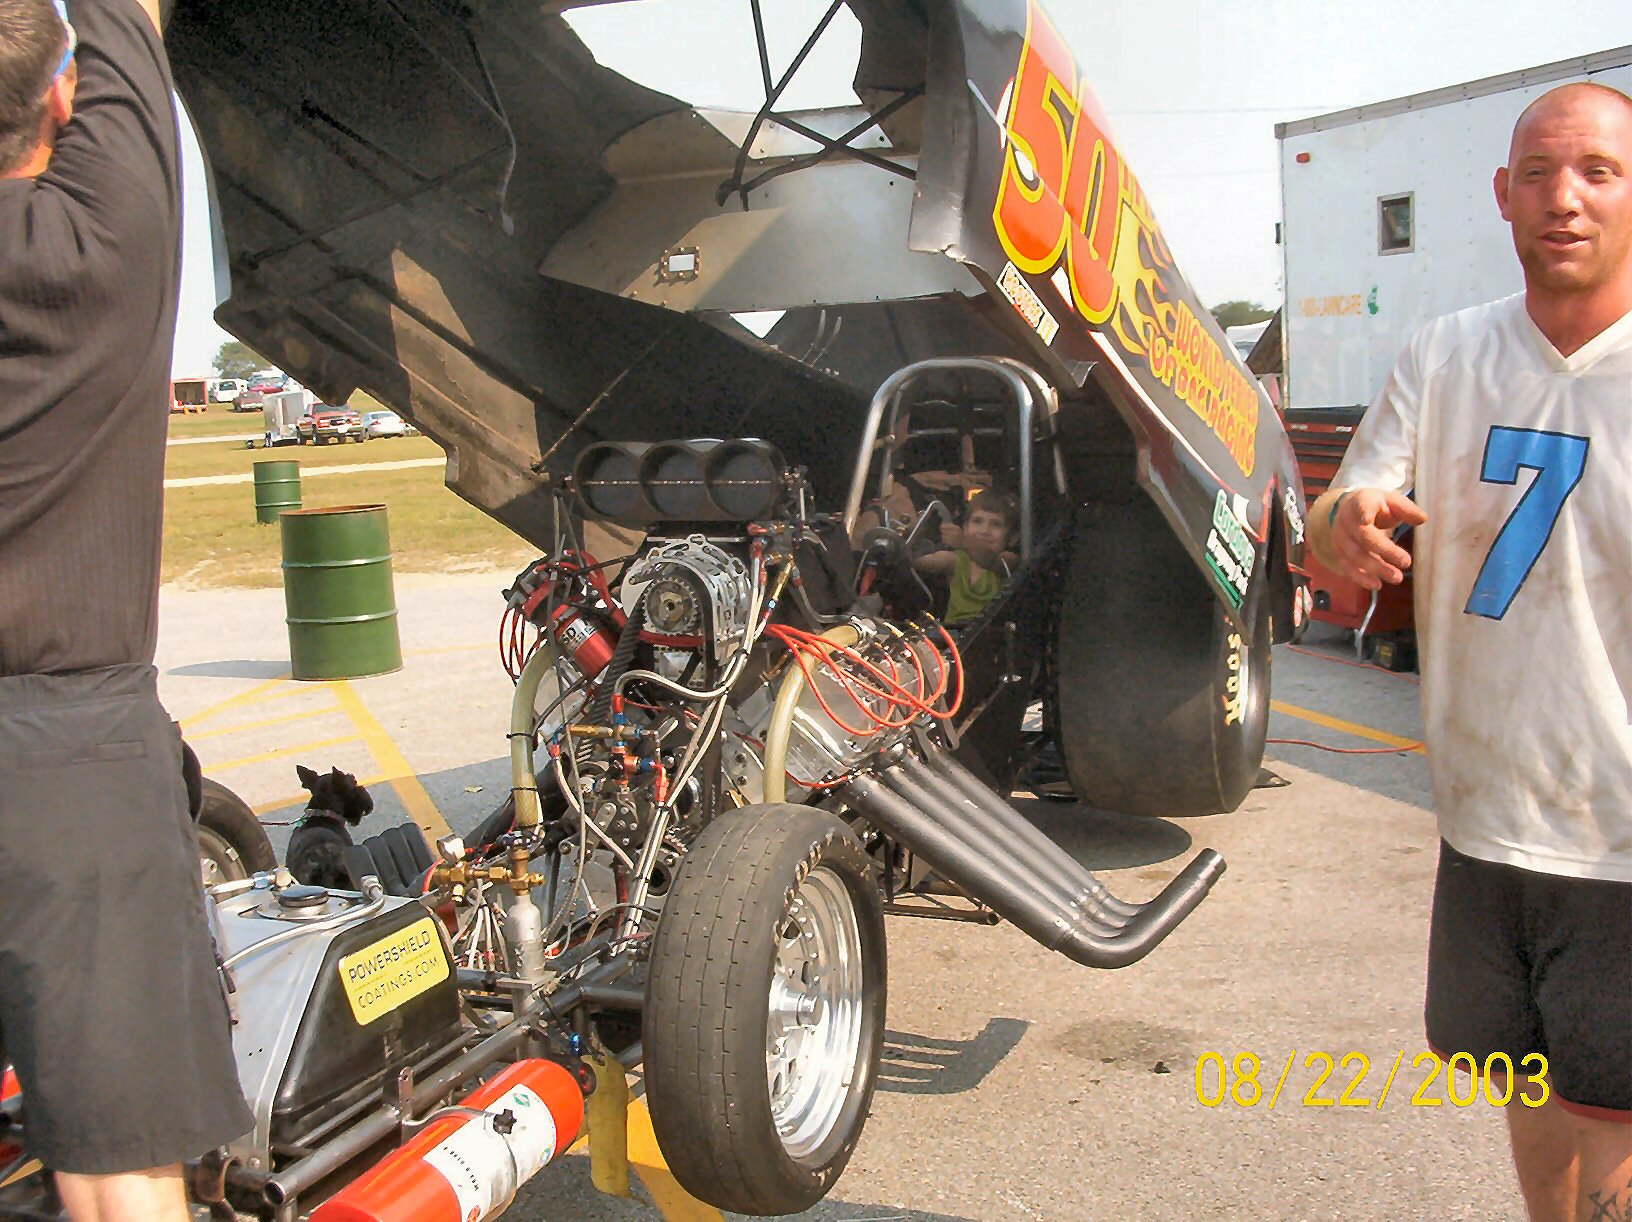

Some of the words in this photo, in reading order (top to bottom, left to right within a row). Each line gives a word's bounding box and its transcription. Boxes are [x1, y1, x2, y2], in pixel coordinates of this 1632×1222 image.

[1463, 424, 1590, 621] 7
[348, 930, 431, 983] POWERSHIELD
[358, 956, 441, 1009] COATINGS.COM
